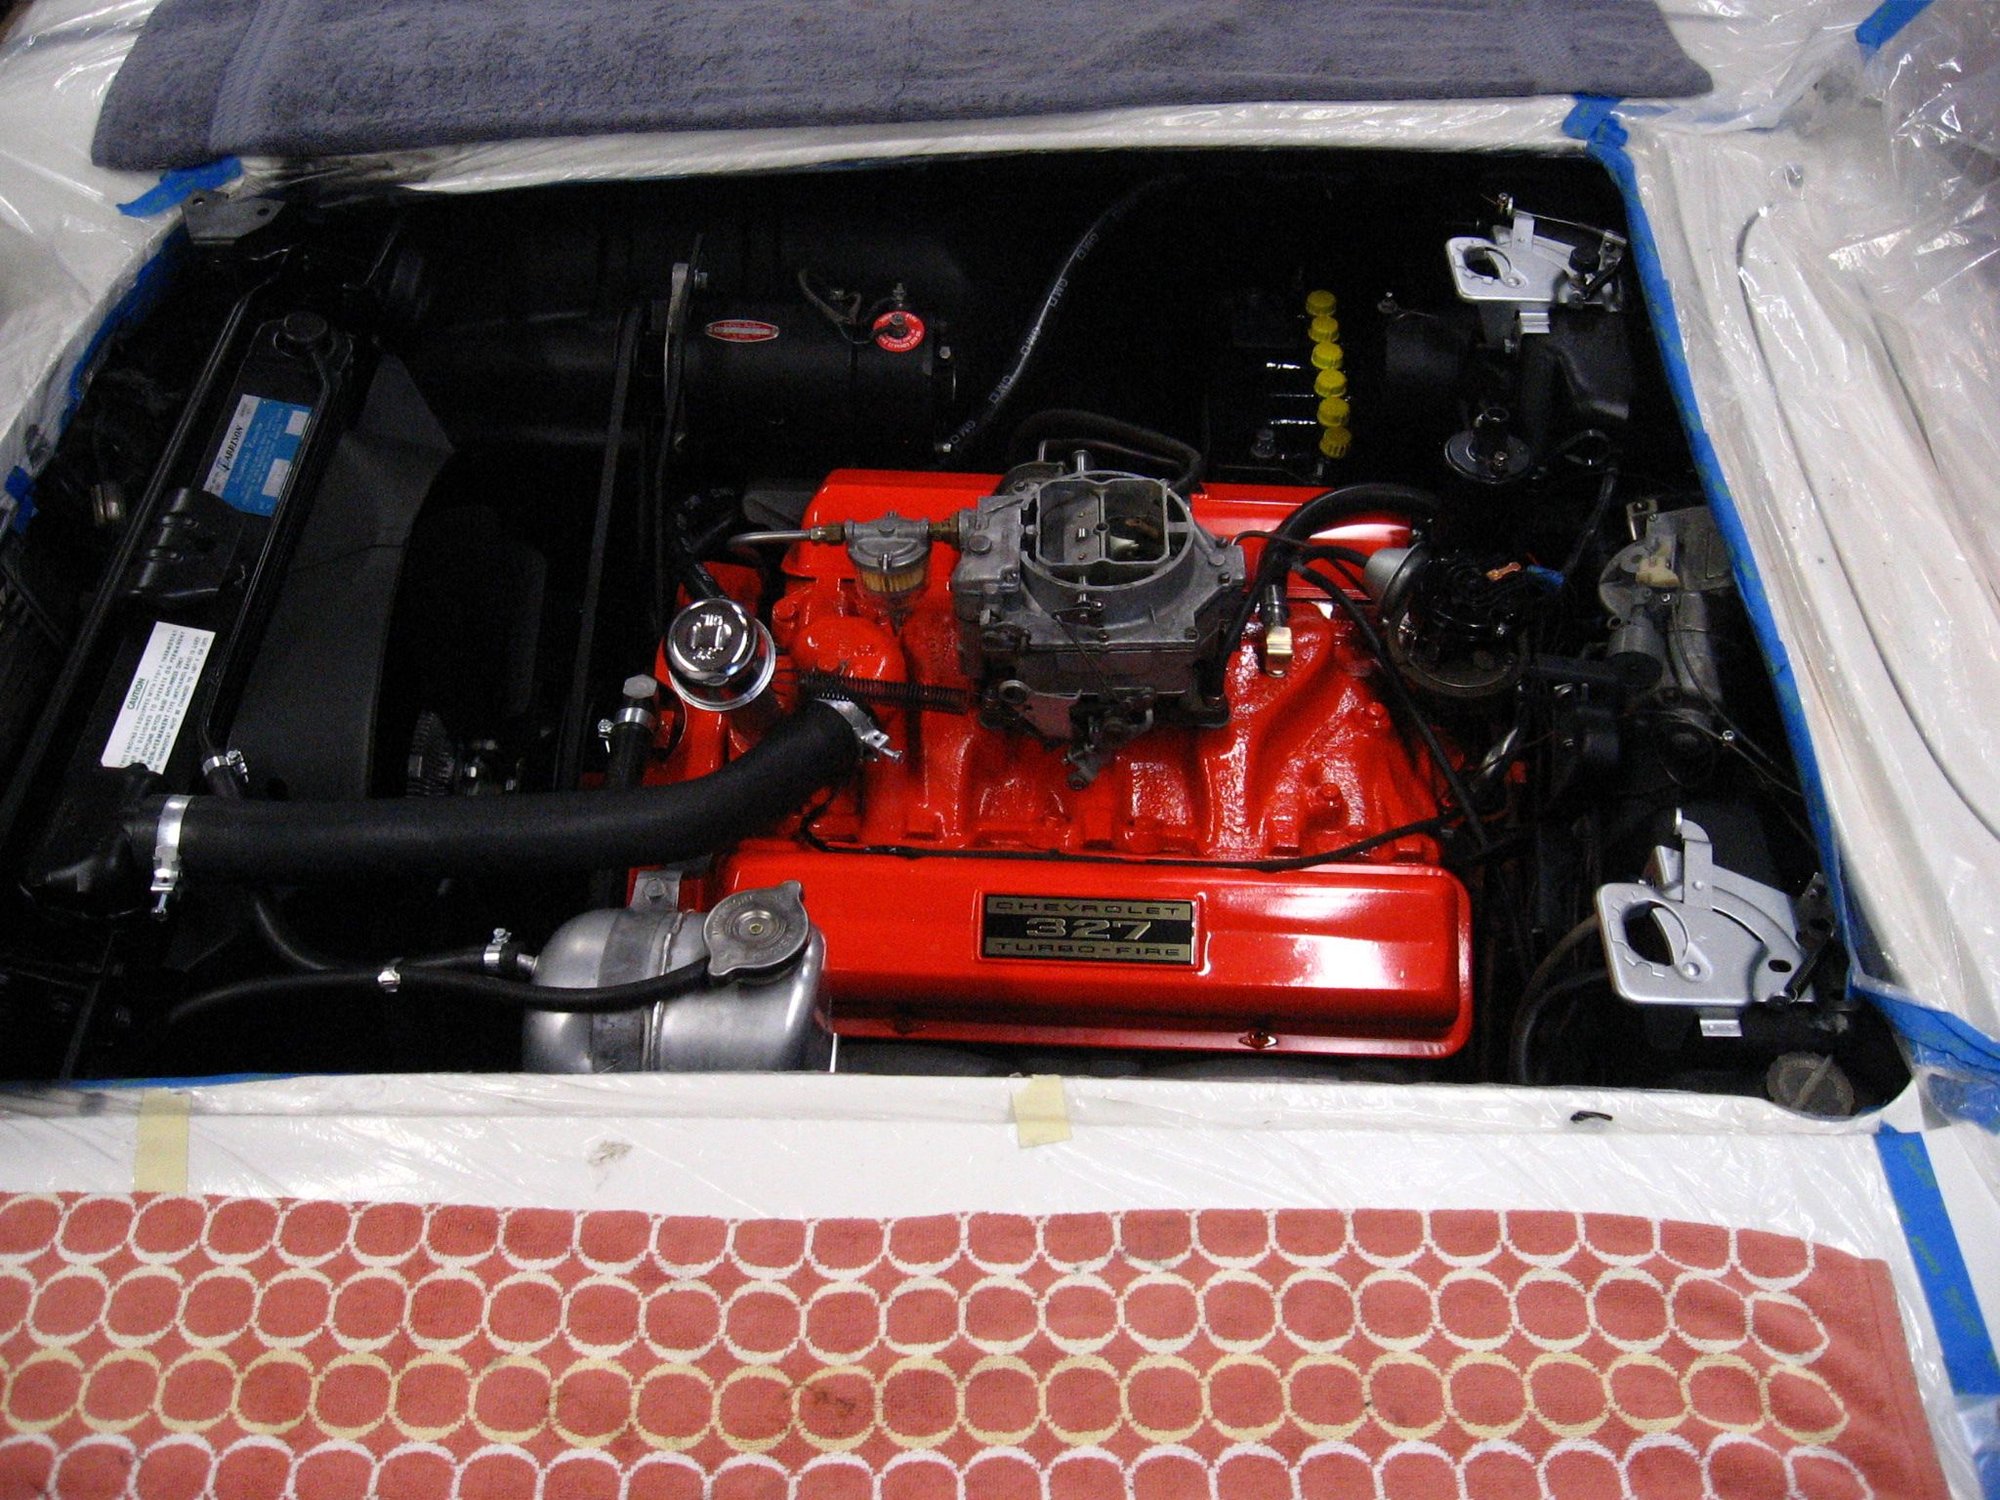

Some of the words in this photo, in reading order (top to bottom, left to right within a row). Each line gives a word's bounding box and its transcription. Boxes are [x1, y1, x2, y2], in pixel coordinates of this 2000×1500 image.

[126, 677, 145, 709] CAUTION
[995, 901, 1180, 917] CHEVROLET
[1026, 917, 1151, 940] 327
[995, 942, 1180, 956] TURBO-FIRE
